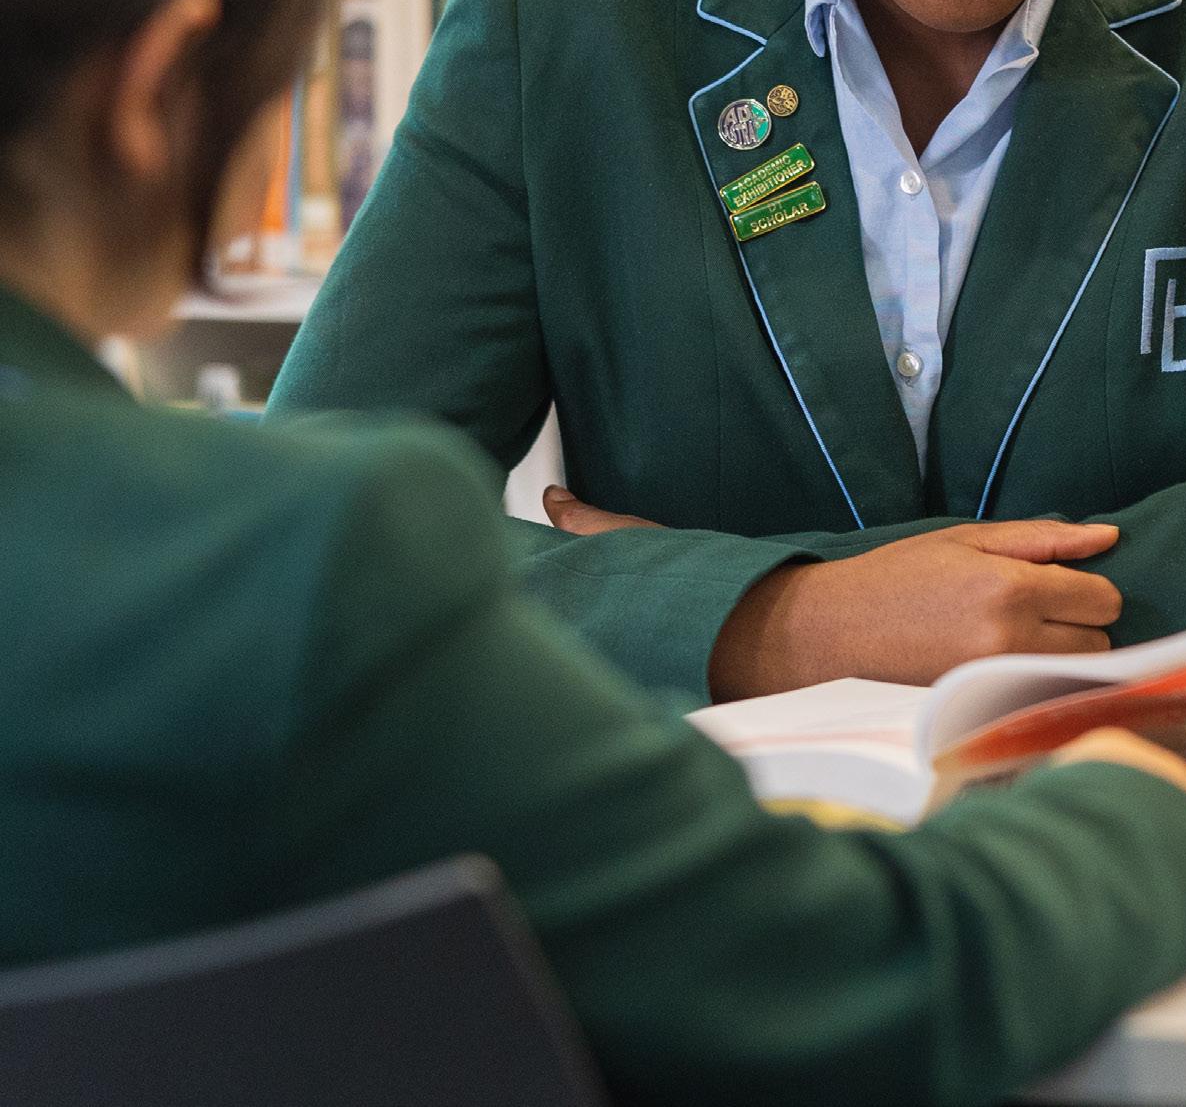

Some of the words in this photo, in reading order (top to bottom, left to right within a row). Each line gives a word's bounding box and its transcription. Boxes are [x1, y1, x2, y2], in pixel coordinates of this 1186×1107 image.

[733, 159, 808, 208] EXHIBITIONER
[737, 154, 792, 192] ACADEMIC
[750, 202, 810, 233] SCHOLAR
